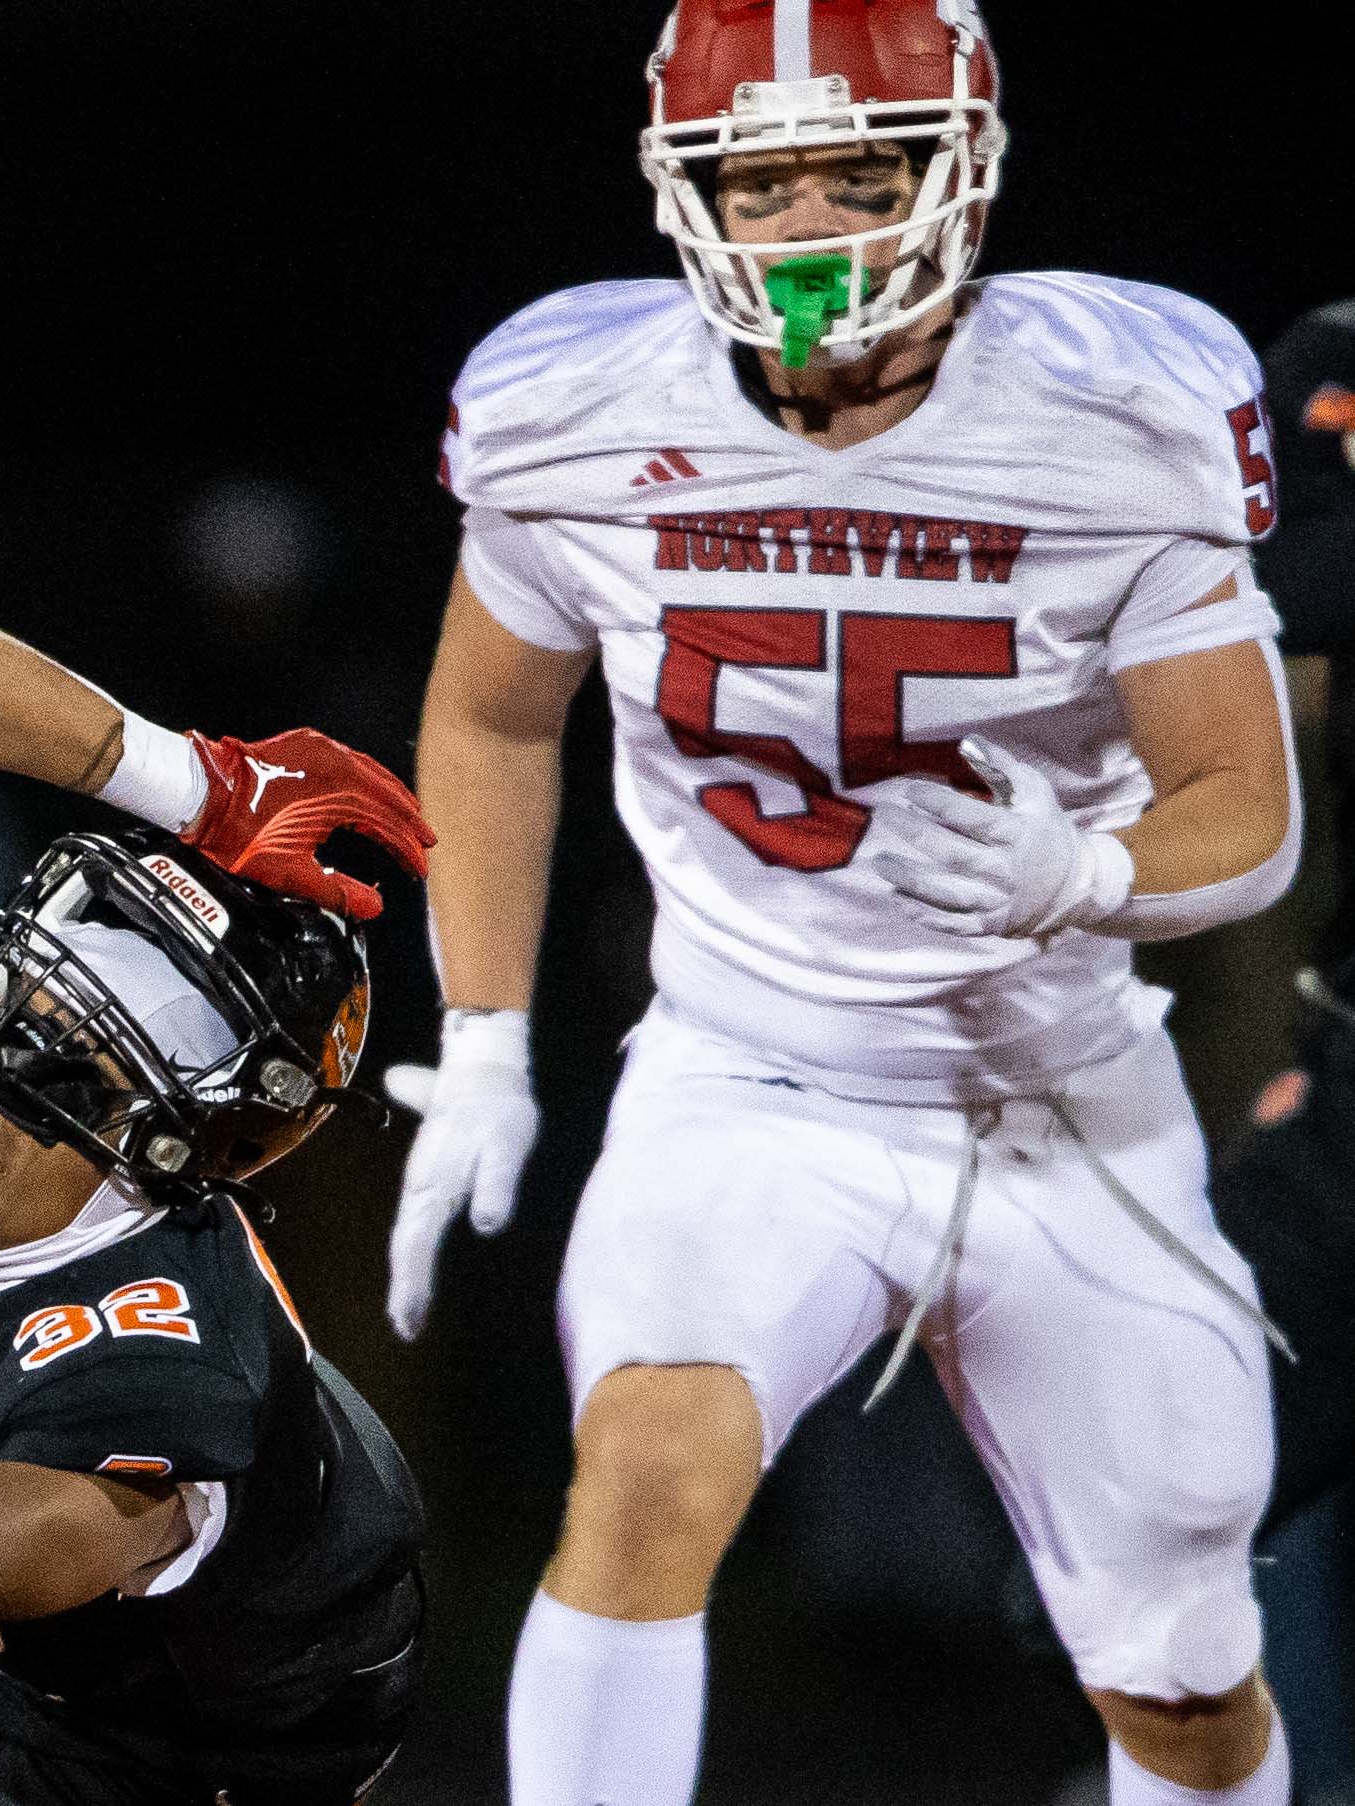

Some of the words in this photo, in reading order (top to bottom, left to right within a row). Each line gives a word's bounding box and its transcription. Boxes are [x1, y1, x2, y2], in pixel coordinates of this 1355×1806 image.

[649, 508, 1027, 584] NORTHVIEW
[658, 606, 1018, 872] 55
[149, 859, 219, 922] Riddell
[14, 1277, 200, 1371] 32
